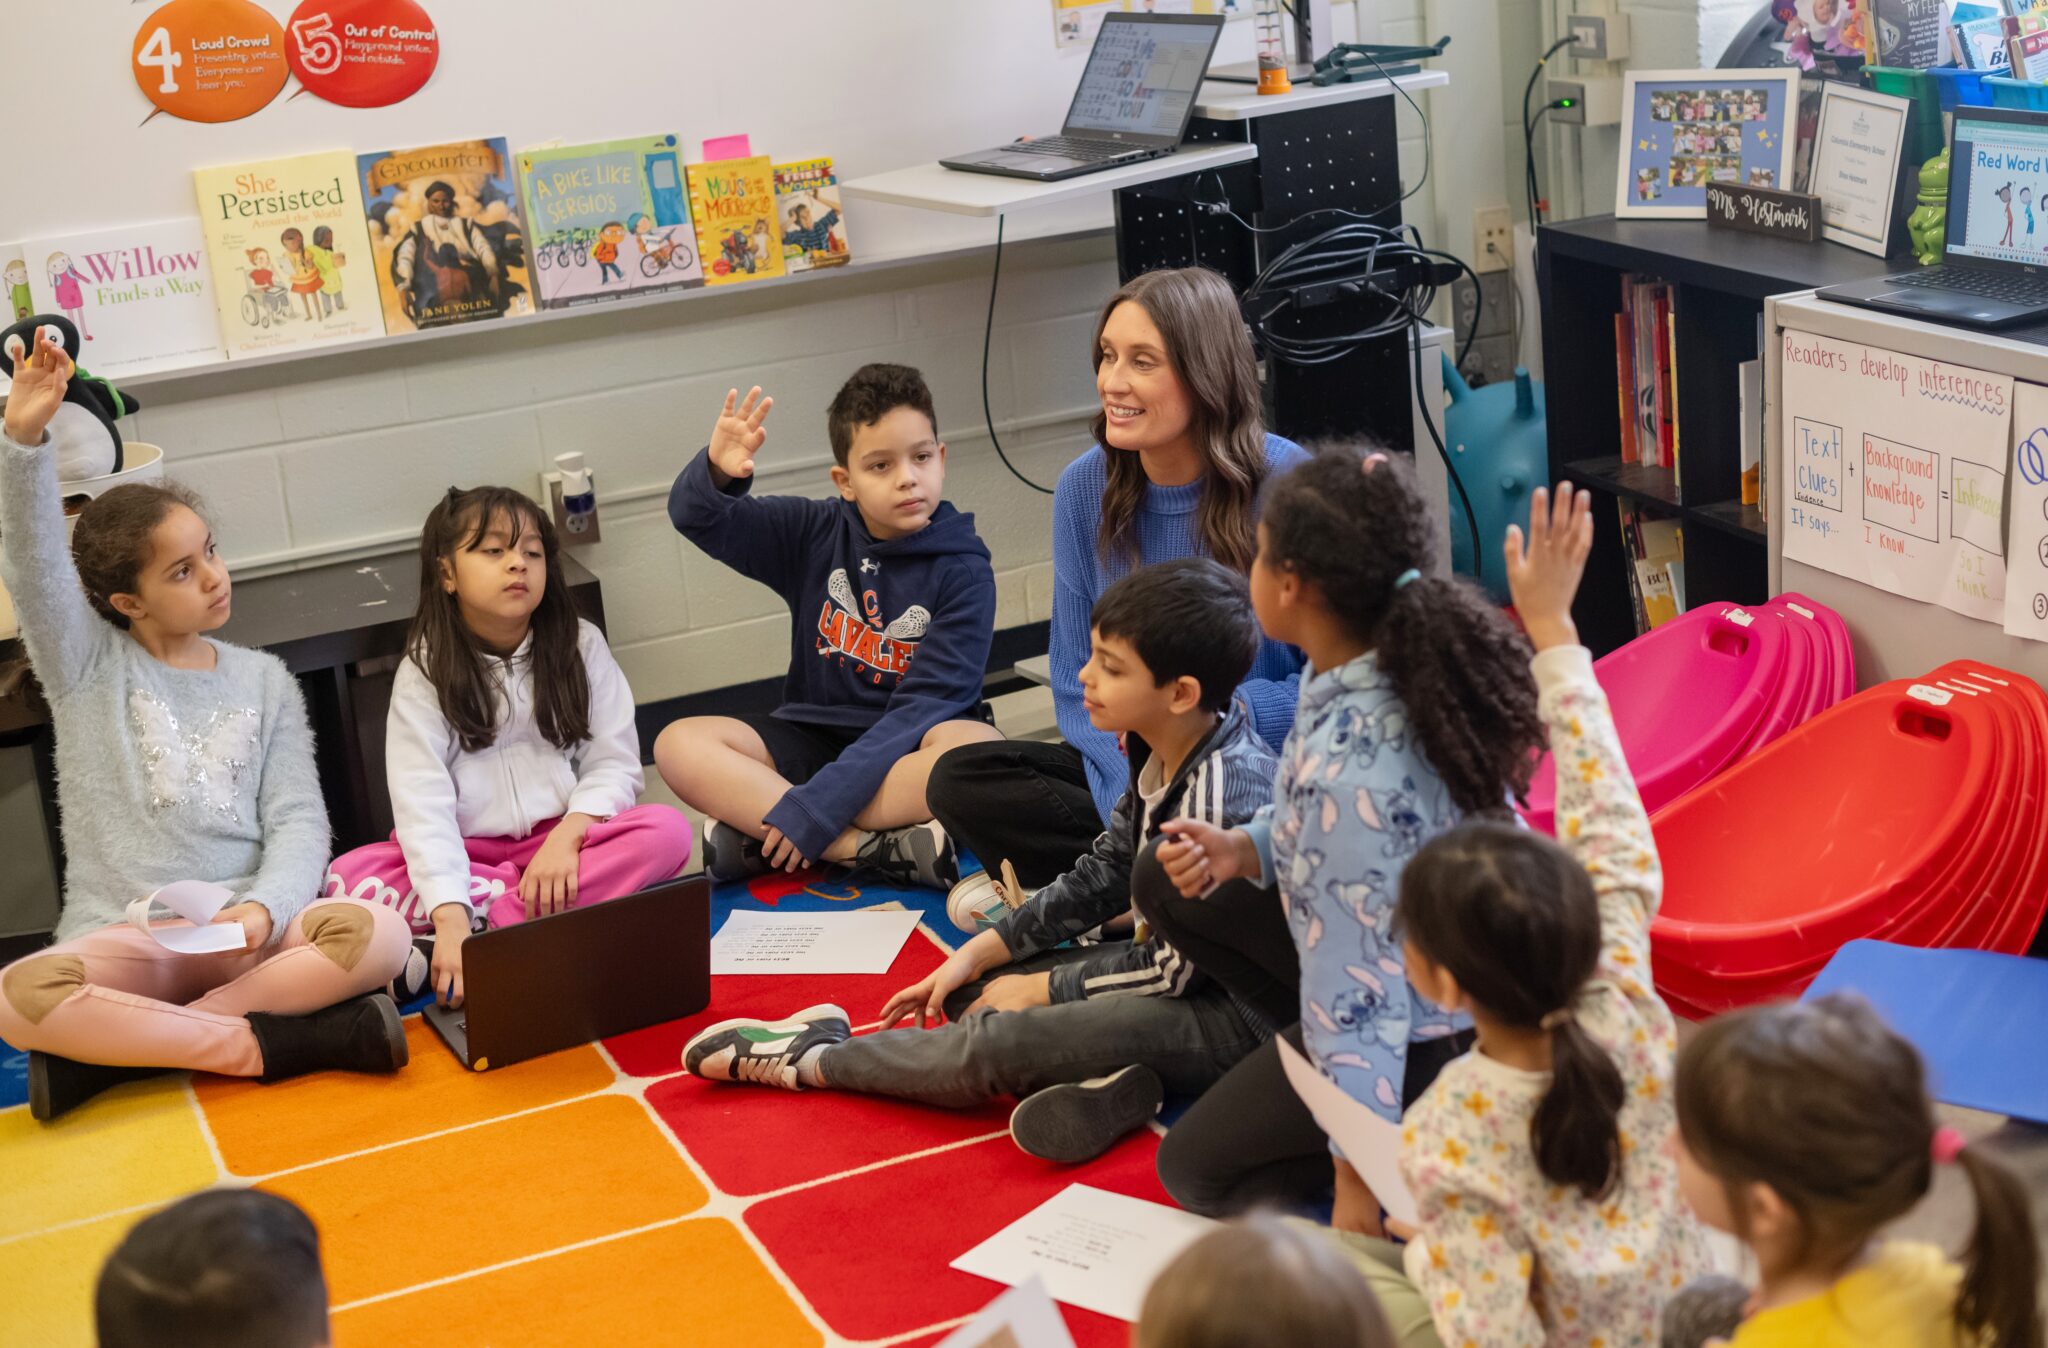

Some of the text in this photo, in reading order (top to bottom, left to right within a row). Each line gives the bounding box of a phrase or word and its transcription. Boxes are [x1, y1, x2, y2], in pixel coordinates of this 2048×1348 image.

[1922, 0, 1938, 15] FEE
[191, 33, 270, 51] Loud Crowd
[291, 12, 341, 75] 5
[344, 23, 435, 41] Out of Control
[137, 26, 182, 94] 4
[195, 65, 243, 79] Everyone
[379, 152, 490, 179] Encounter
[1977, 150, 2002, 169] Red
[2006, 152, 2041, 174] Word
[235, 172, 277, 196] She
[536, 164, 634, 200] A BIKE LIKE
[778, 177, 832, 195] WORMS
[218, 177, 344, 220] Persisted
[546, 192, 617, 225] SERGIO'S
[1708, 187, 1739, 220] Ms.
[292, 212, 310, 223] the
[312, 206, 343, 220] World
[81, 245, 202, 284] Willow
[2024, 266, 2037, 274] DELL
[96, 277, 204, 306] Finds a Way
[422, 303, 450, 319] JANE
[453, 300, 492, 312] YOLEN
[1785, 336, 1847, 372] Readers
[1860, 349, 1909, 398] develop
[1801, 428, 1840, 460] Text
[1865, 440, 1934, 486] Background
[1798, 464, 1838, 498] Clues
[1864, 478, 1926, 525] Knowledge
[1791, 507, 1840, 538] It says...
[1864, 526, 1871, 545] I
[1960, 550, 1986, 577] So I
